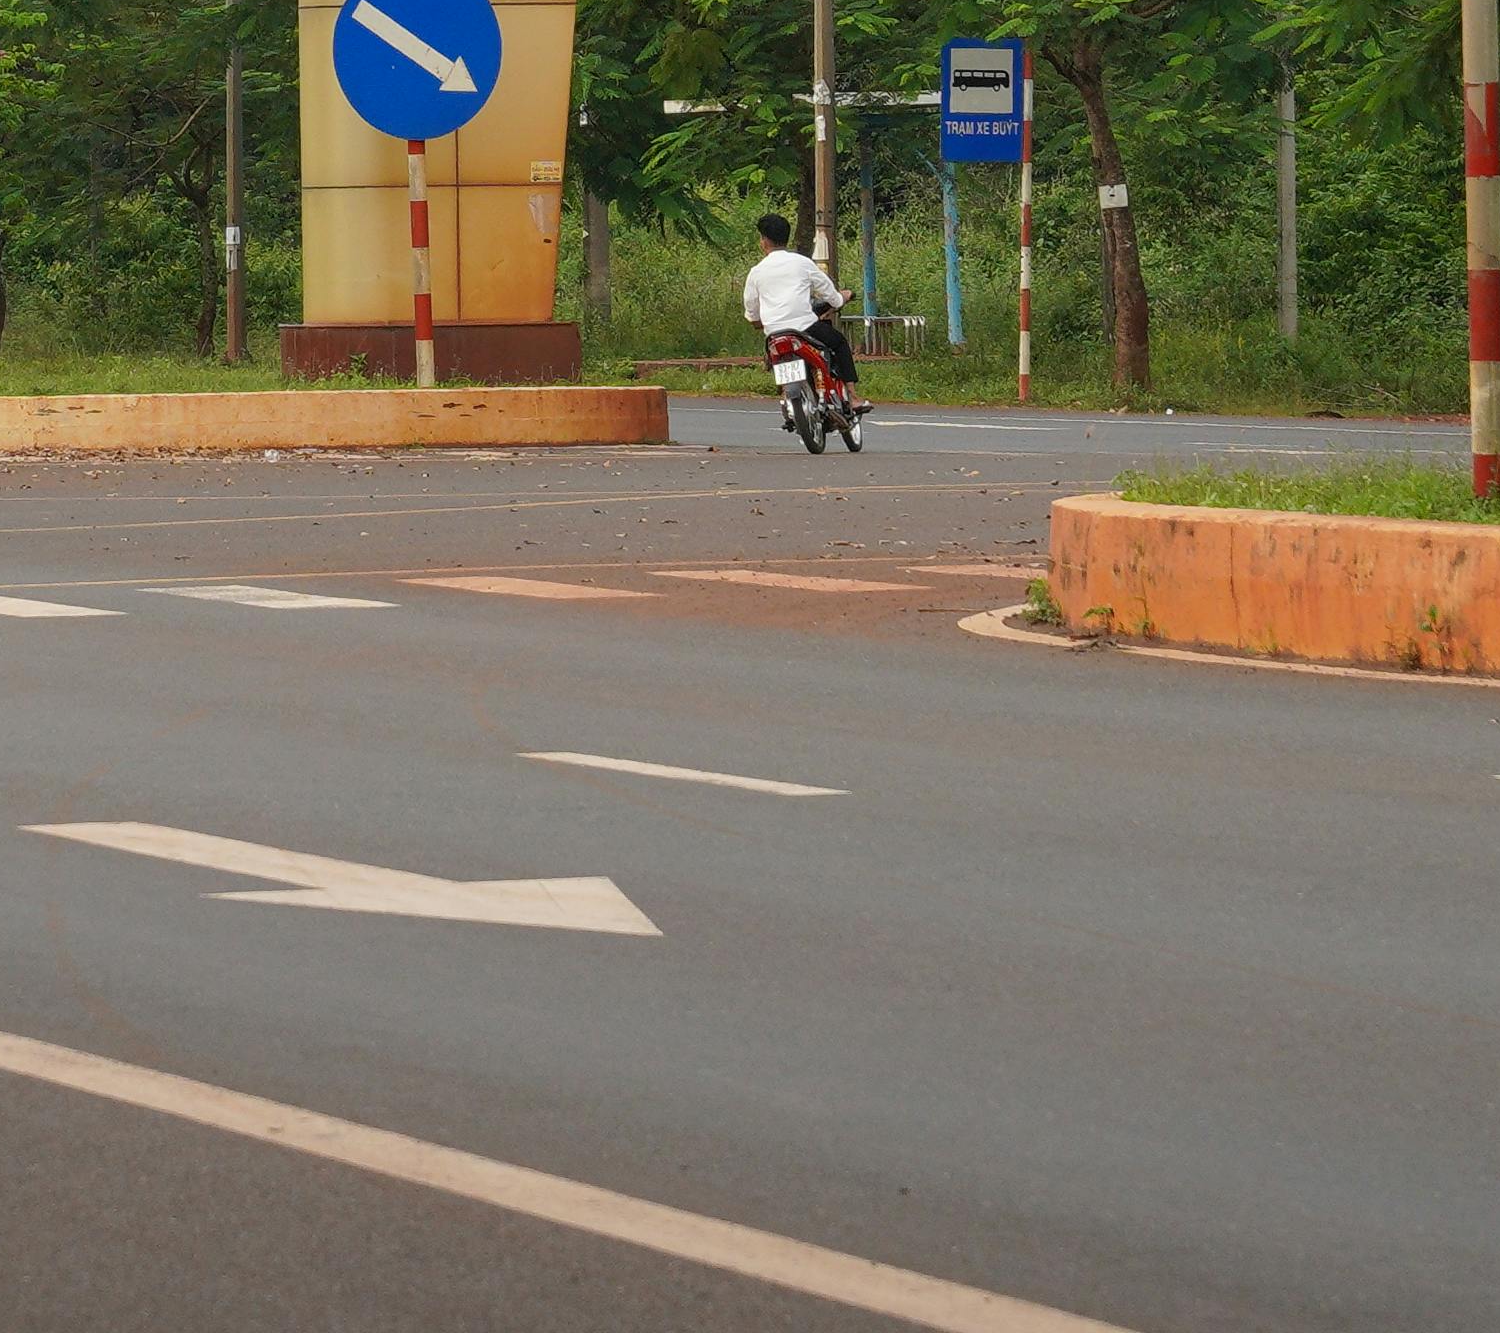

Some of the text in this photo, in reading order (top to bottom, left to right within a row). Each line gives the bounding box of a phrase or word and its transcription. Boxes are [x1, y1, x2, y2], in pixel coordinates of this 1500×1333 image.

[946, 119, 1020, 136] TRẠM XE BUÝT
